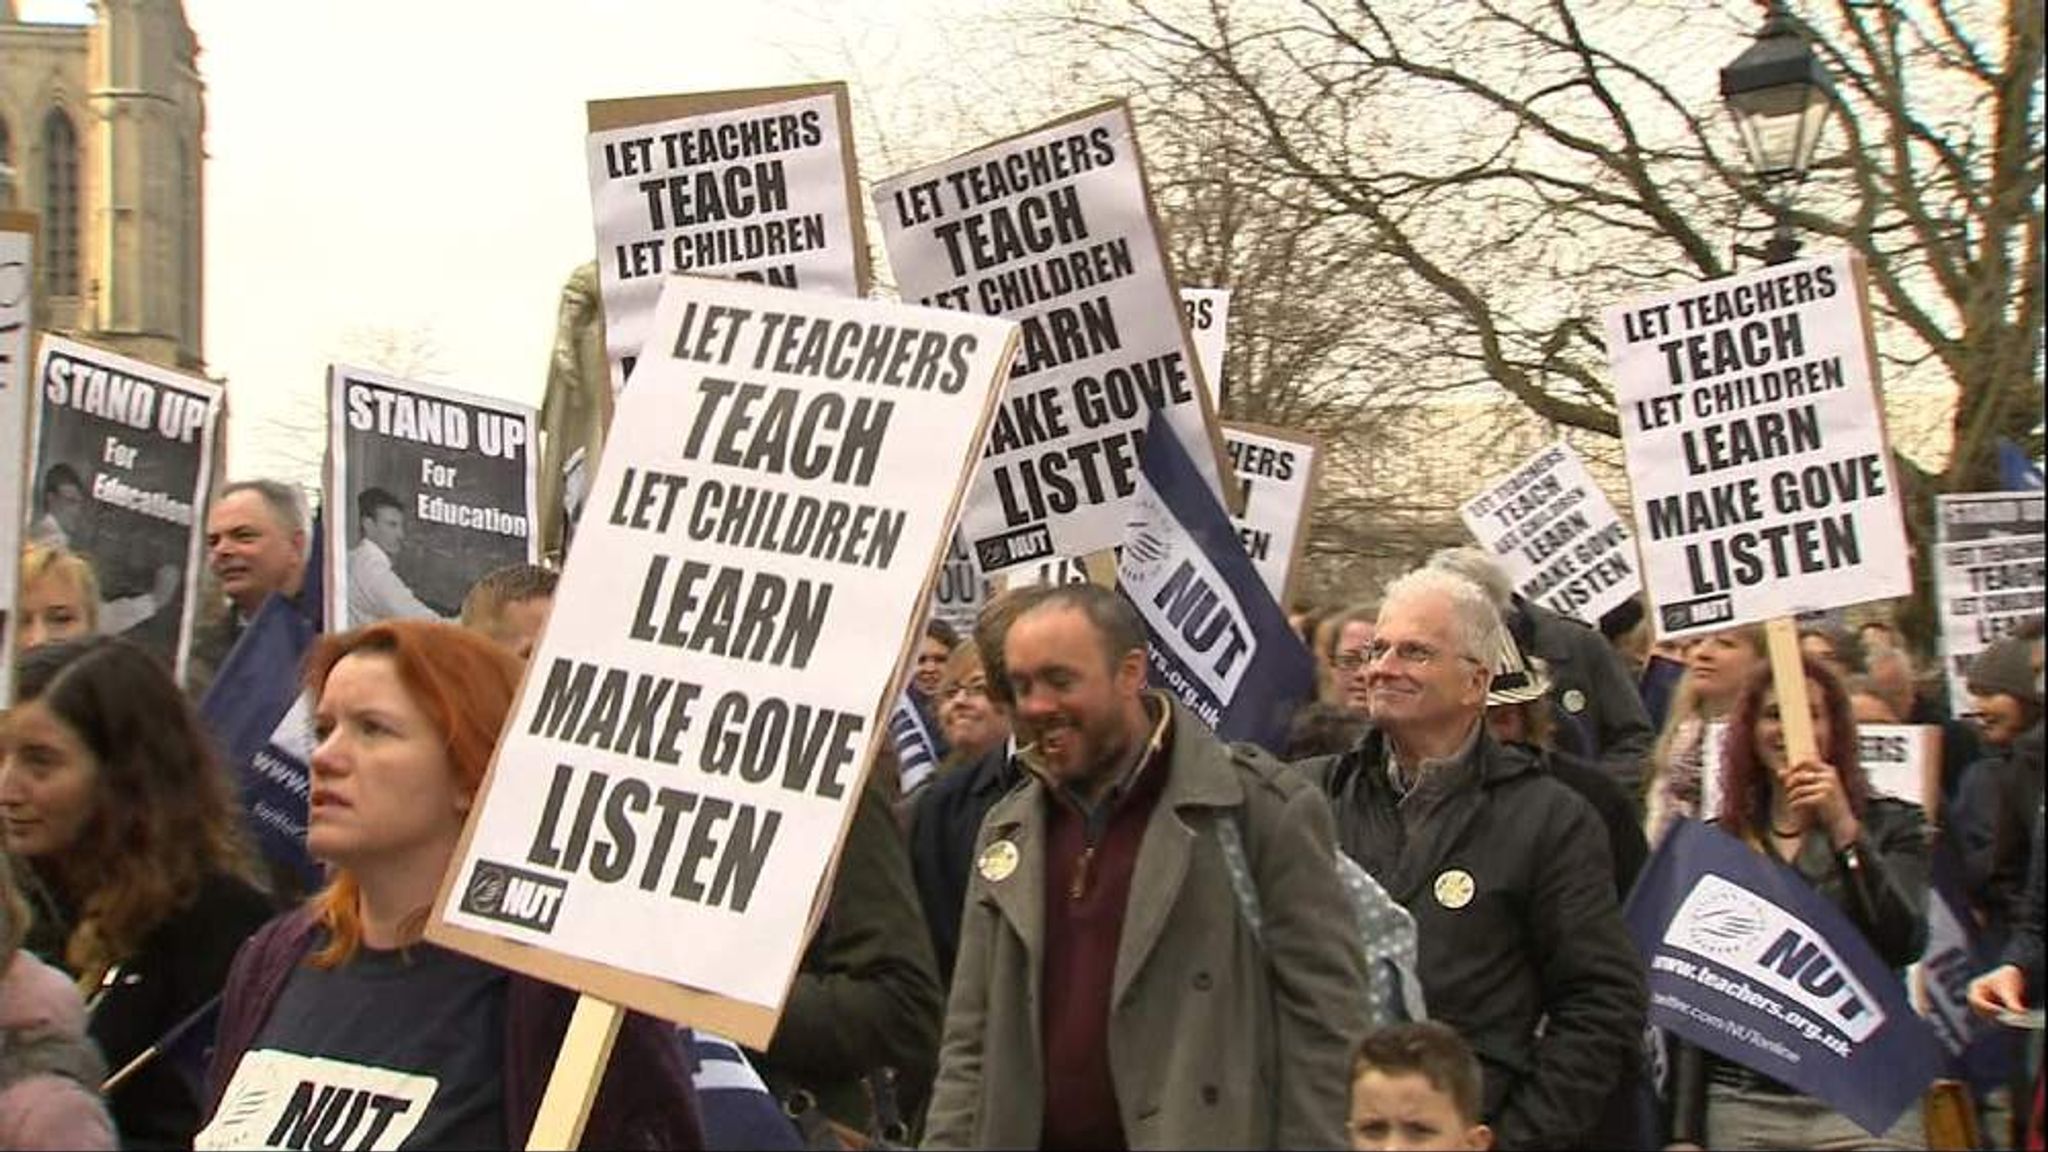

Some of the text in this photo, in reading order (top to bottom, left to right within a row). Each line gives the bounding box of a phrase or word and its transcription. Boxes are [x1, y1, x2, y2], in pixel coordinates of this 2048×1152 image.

[606, 110, 822, 178] LET TEACHERS
[895, 127, 1115, 228] LET TEACHERS
[640, 160, 788, 231] TEACH
[935, 185, 1090, 278] TEACH
[616, 238, 664, 280] LET
[672, 213, 825, 275] CHILDREN
[977, 238, 1136, 316] CHILDREN
[1623, 265, 1837, 343] LET TEACHERS
[672, 302, 978, 396] LET TEACHERS
[1659, 313, 1806, 386] TEACH
[46, 357, 156, 431] STAND
[158, 388, 207, 444] UP
[348, 384, 524, 460] STAND UP
[682, 376, 895, 487] TEACH
[984, 352, 1193, 458] AKE GOVE
[1636, 356, 1845, 431] LET CHILDREN
[104, 436, 138, 470] For
[421, 460, 457, 489] For
[1681, 404, 1822, 476] LEARN
[92, 472, 191, 526] Education
[417, 494, 527, 539] Education
[609, 468, 688, 533] LET
[687, 479, 907, 570] CHILDREN
[1494, 473, 1563, 527] TEACH
[1646, 454, 1885, 541] MAKE GOVE
[1007, 529, 1048, 560] NUT
[1520, 521, 1631, 599] MAKE GOVE
[1521, 510, 1590, 564] LEARN
[1685, 513, 1862, 596] LISTEN
[629, 555, 833, 669] LEARN
[1153, 557, 1247, 679] NUT
[1549, 550, 1633, 615] LISTEN
[528, 657, 865, 800] MAKE GOVE
[526, 764, 783, 914] LISTEN
[501, 876, 564, 924] NUT
[1757, 929, 1867, 1020] NUT
[265, 1080, 412, 1151] NUT
